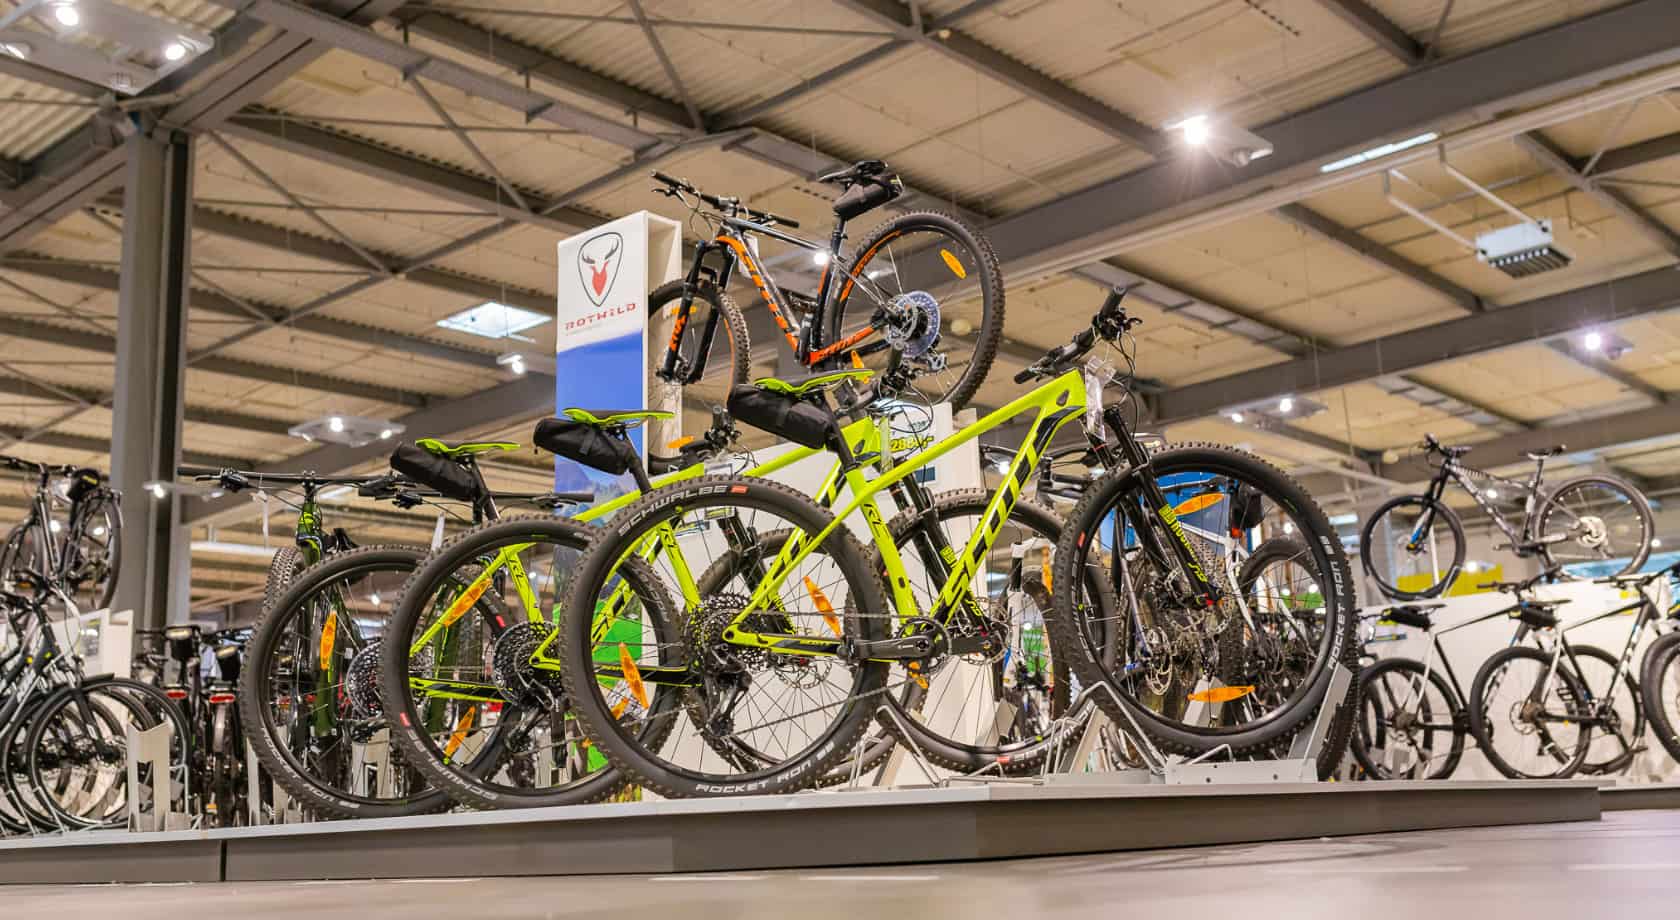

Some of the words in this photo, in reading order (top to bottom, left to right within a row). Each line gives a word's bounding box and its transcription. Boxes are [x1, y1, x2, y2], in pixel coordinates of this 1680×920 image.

[618, 484, 728, 537] SCHWALBE
[1330, 560, 1345, 597] RON
[1328, 602, 1346, 671] ROCKET
[407, 728, 499, 800] SCHWALBE
[695, 779, 769, 794] ROCKET
[776, 759, 812, 784] RON
[303, 783, 336, 802] RON
